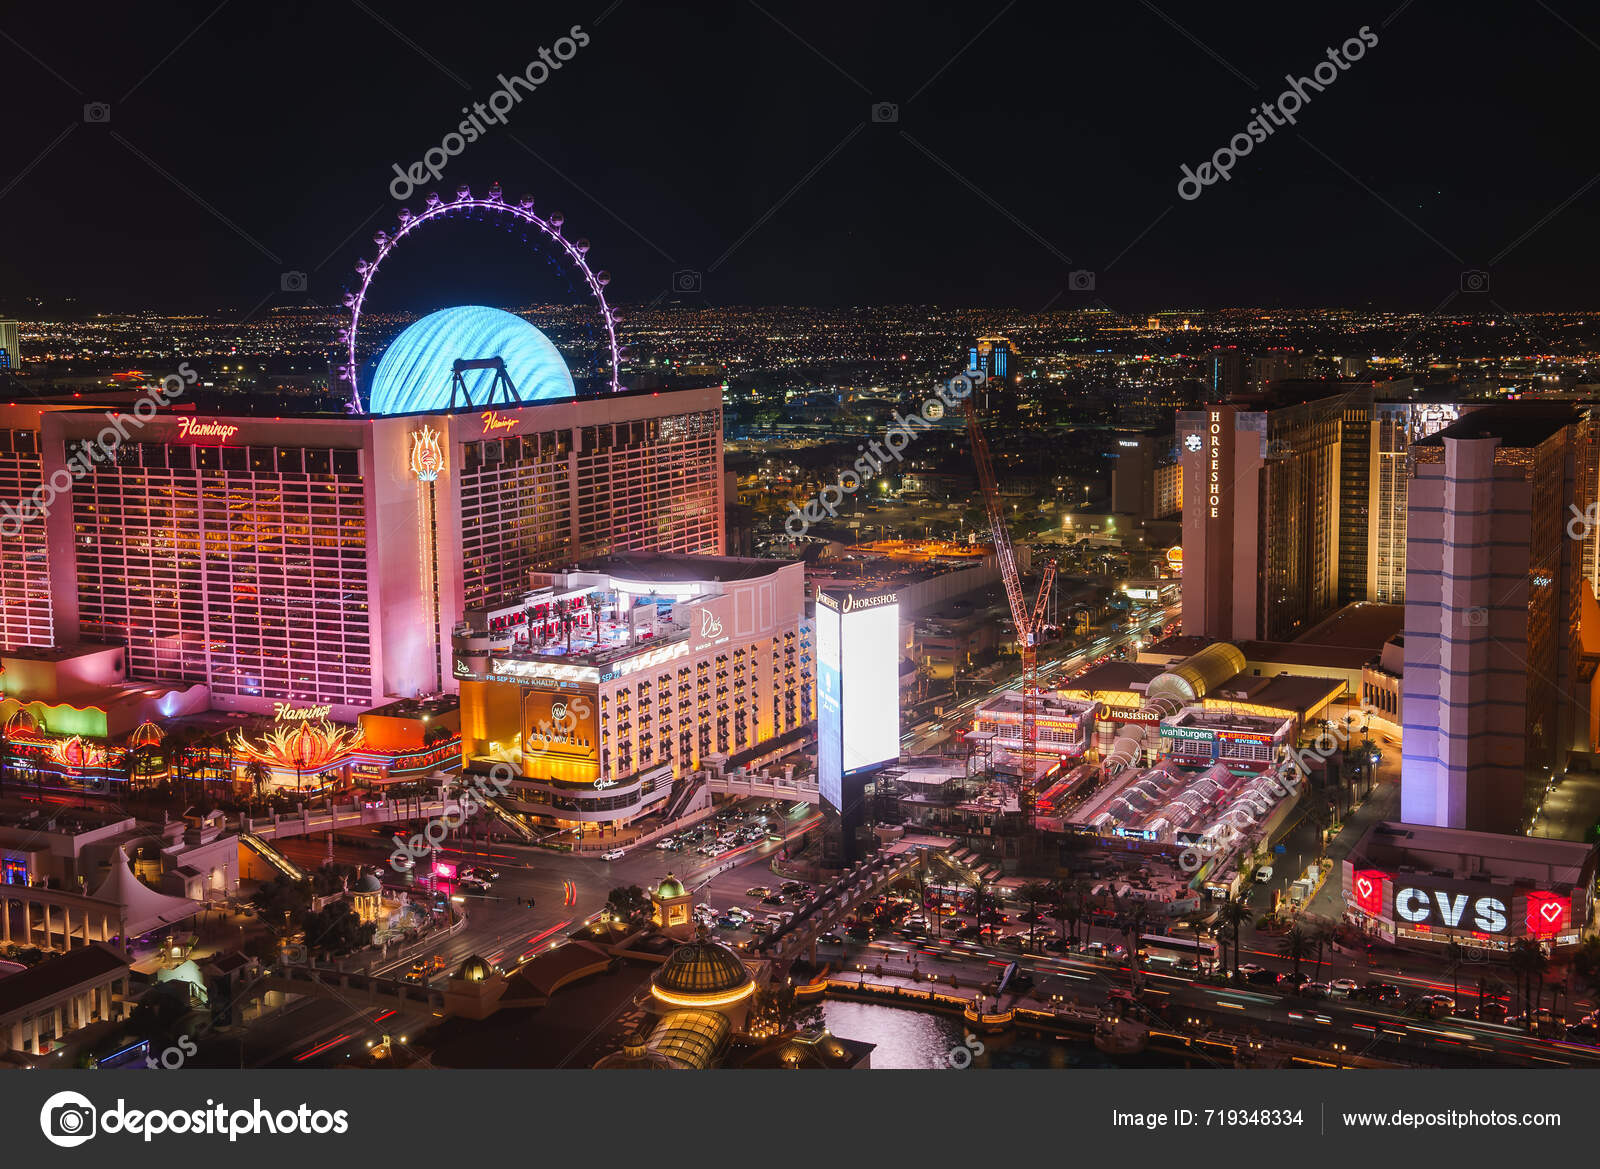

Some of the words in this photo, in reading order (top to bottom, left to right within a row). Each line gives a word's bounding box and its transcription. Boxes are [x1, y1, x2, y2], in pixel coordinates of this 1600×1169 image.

[177, 416, 239, 443] Flamingo
[481, 411, 519, 433] Flamingo
[1209, 411, 1220, 518] HORSESHOE
[853, 593, 898, 609] HORSESHOE
[274, 702, 333, 722] Flamingo
[1111, 710, 1159, 720] HORSESHOE
[531, 732, 590, 747] CROMWELL
[1160, 727, 1213, 740] wahlburgers
[1227, 733, 1272, 742] REDNECK
[1396, 887, 1507, 932] CVS
